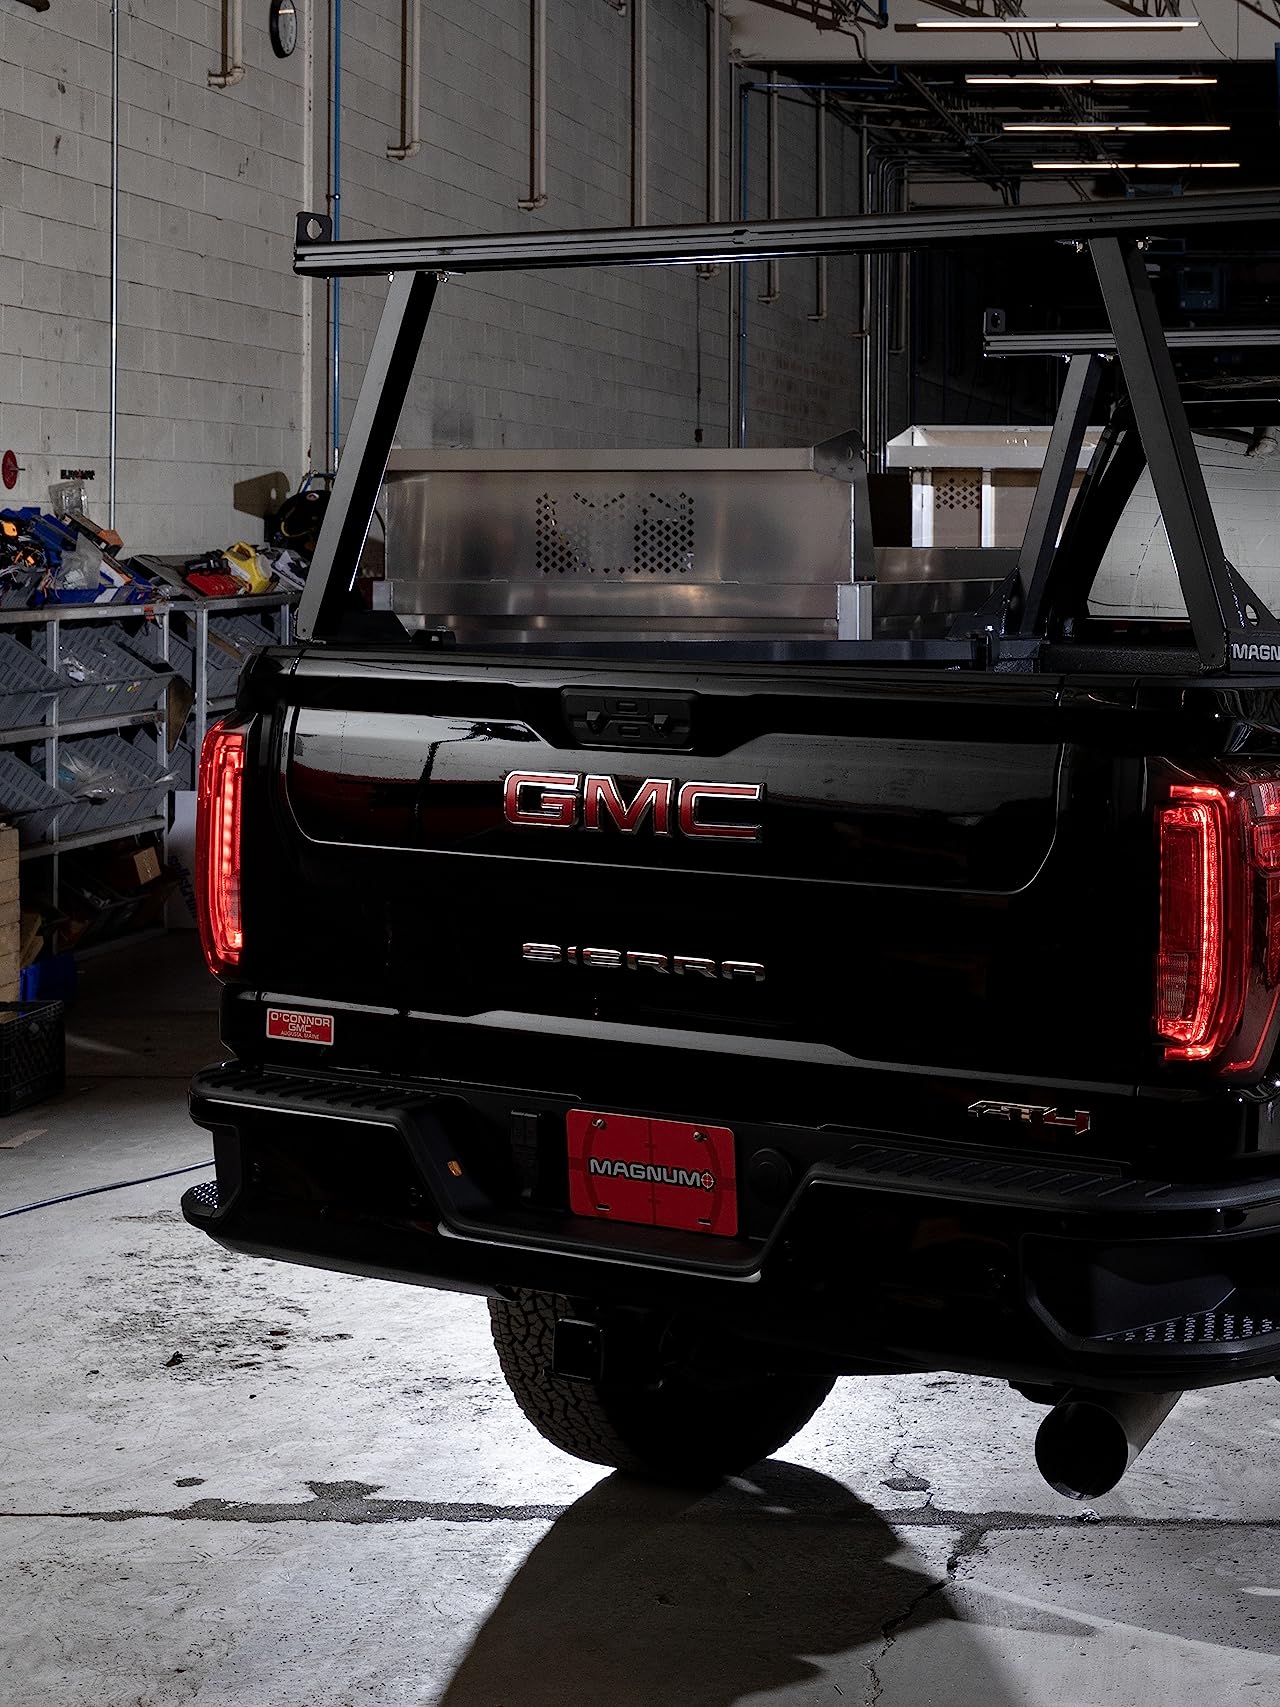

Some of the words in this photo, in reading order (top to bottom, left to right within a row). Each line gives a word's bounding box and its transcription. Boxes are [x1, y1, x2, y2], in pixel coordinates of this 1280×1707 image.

[504, 770, 765, 840] GMC
[522, 942, 766, 982] SIERRA
[270, 1012, 331, 1028] O'CONNOR
[288, 1023, 312, 1034] GMC
[303, 1031, 320, 1040] MAINE
[967, 1100, 1091, 1135] AT4
[590, 1158, 701, 1187] MAGNUM
